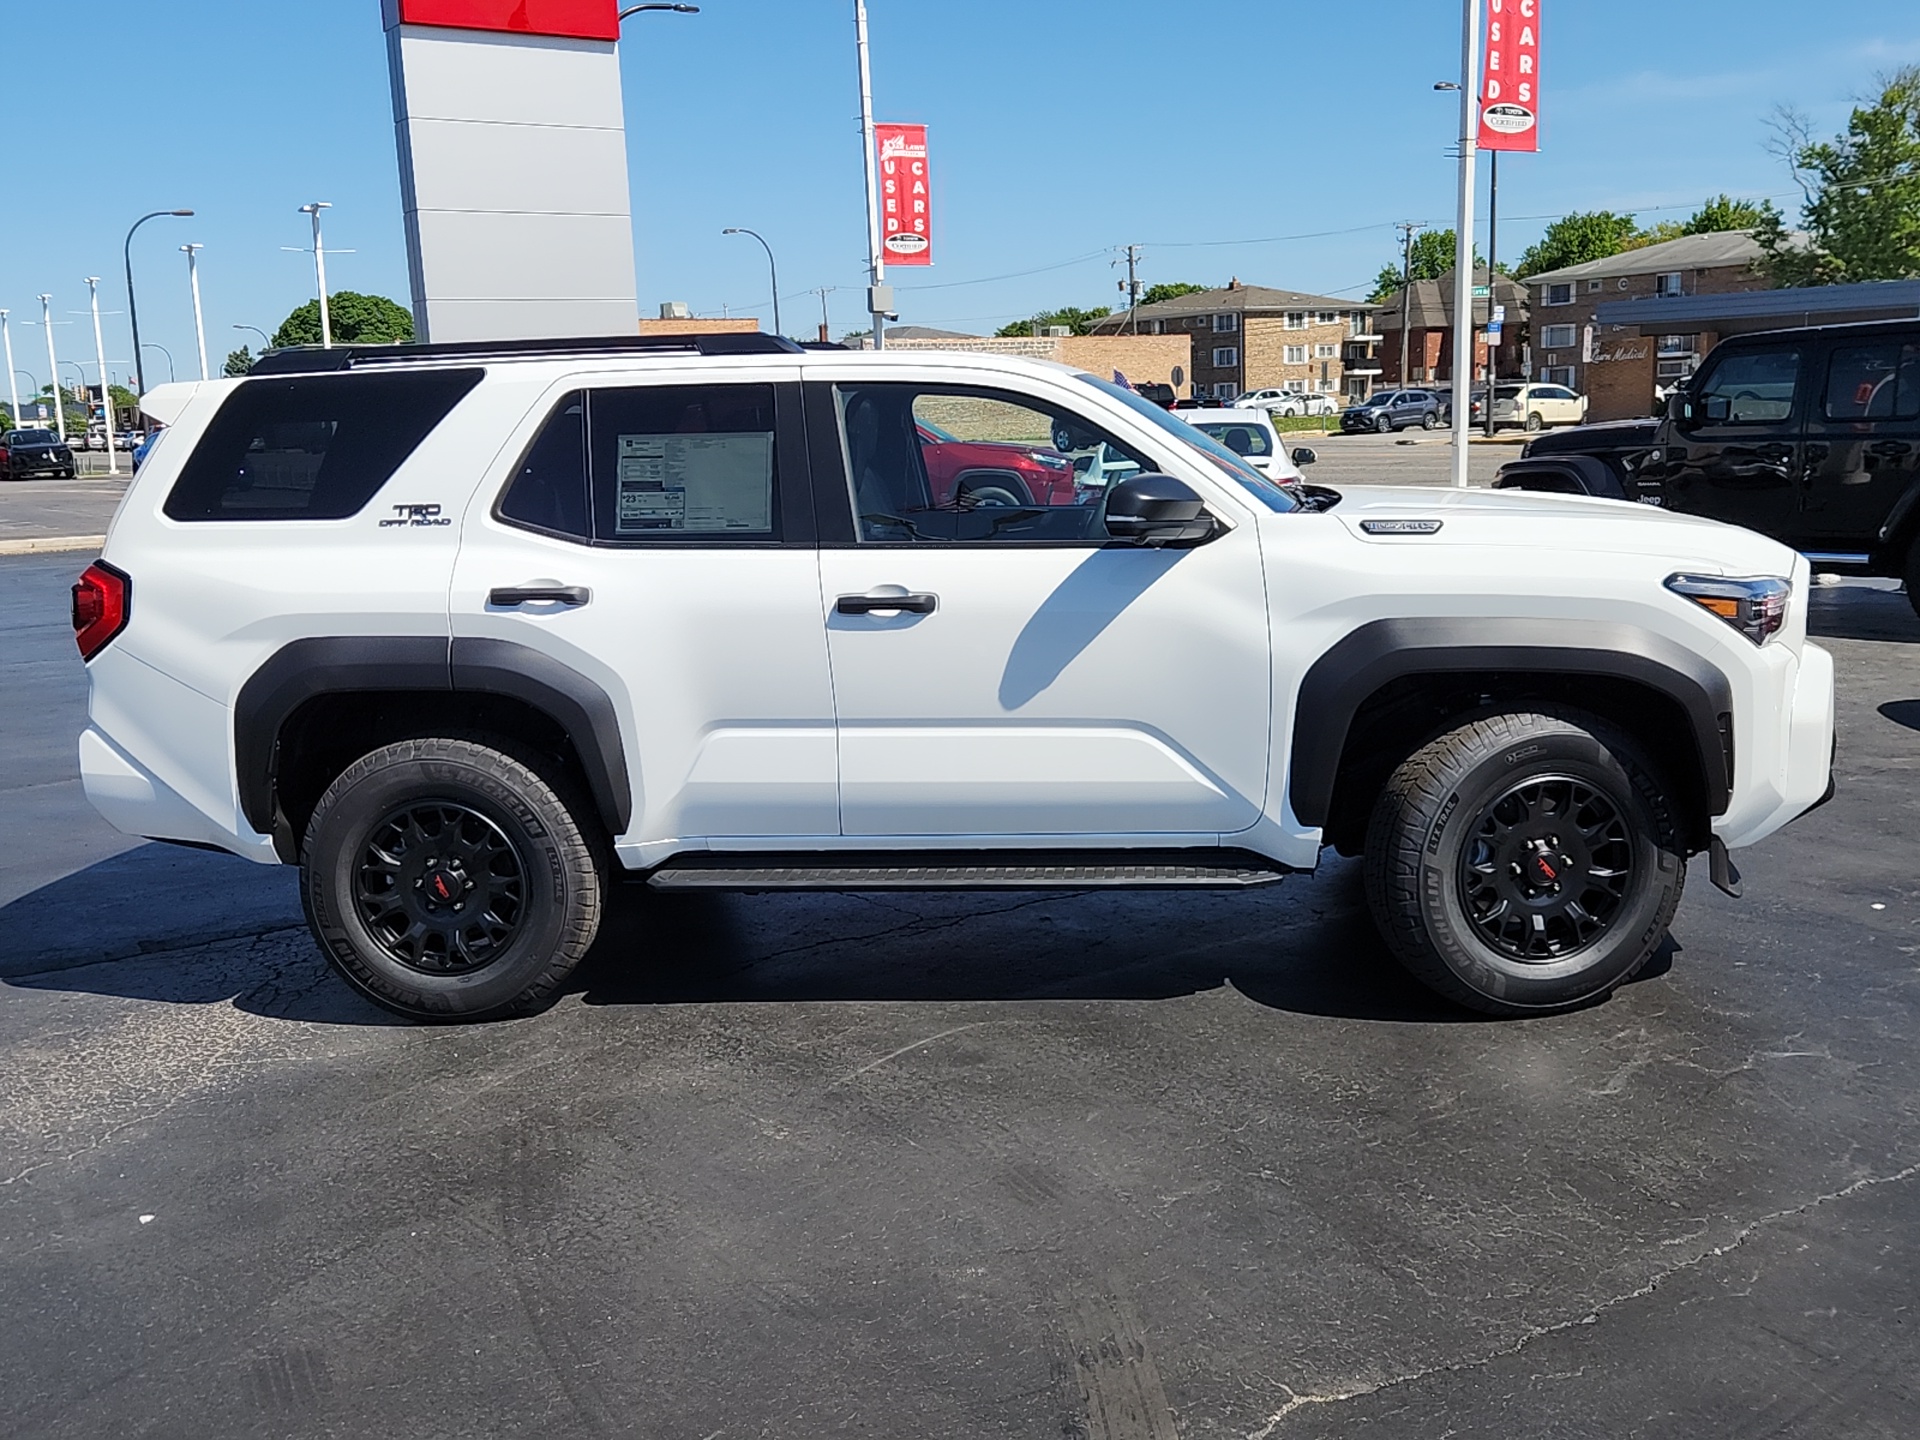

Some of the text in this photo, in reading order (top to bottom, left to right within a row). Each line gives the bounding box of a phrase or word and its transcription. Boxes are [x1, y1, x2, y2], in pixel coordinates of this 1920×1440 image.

[1488, 0, 1502, 99] USED
[1518, 0, 1535, 102] CARS
[884, 161, 898, 231] USED
[911, 162, 925, 232] CARS
[1611, 346, 1648, 362] Medical
[392, 504, 441, 520] TRD
[410, 518, 451, 527] ROAD
[1637, 494, 1661, 506] Jeep
[455, 769, 544, 837] MICHELIN
[1438, 800, 1457, 828] TRAIL
[1537, 857, 1557, 879] TRD
[1427, 871, 1472, 969] MICHELIN
